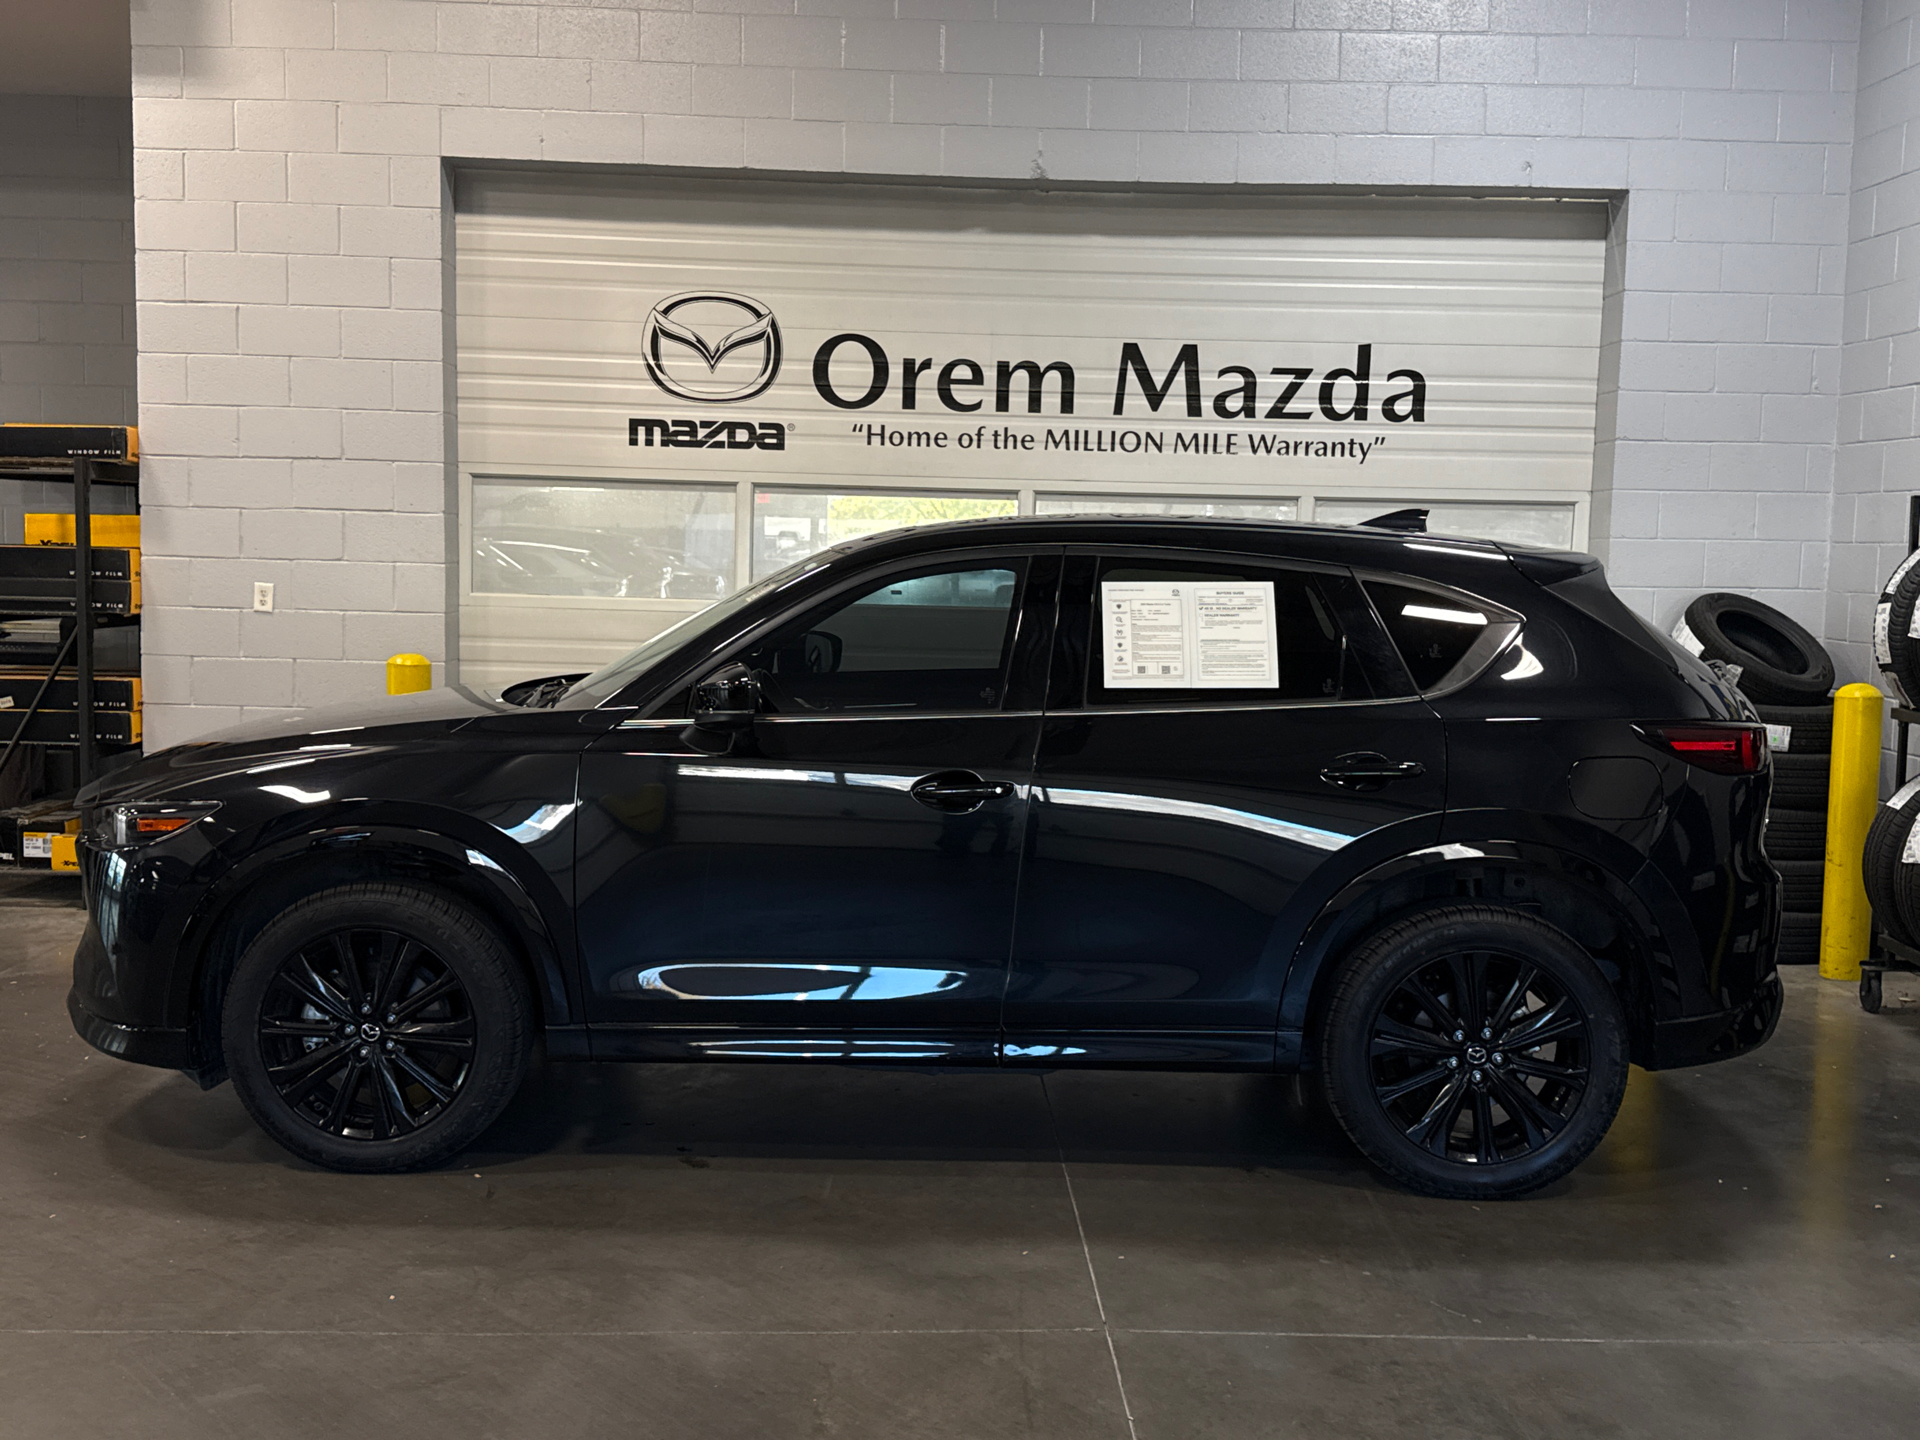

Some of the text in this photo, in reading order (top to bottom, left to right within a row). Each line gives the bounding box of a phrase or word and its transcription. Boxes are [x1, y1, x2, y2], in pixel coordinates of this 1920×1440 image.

[813, 333, 1427, 423] Orem Mazda
[852, 423, 1387, 465] “Home of the MILLION MILE Warranty”
